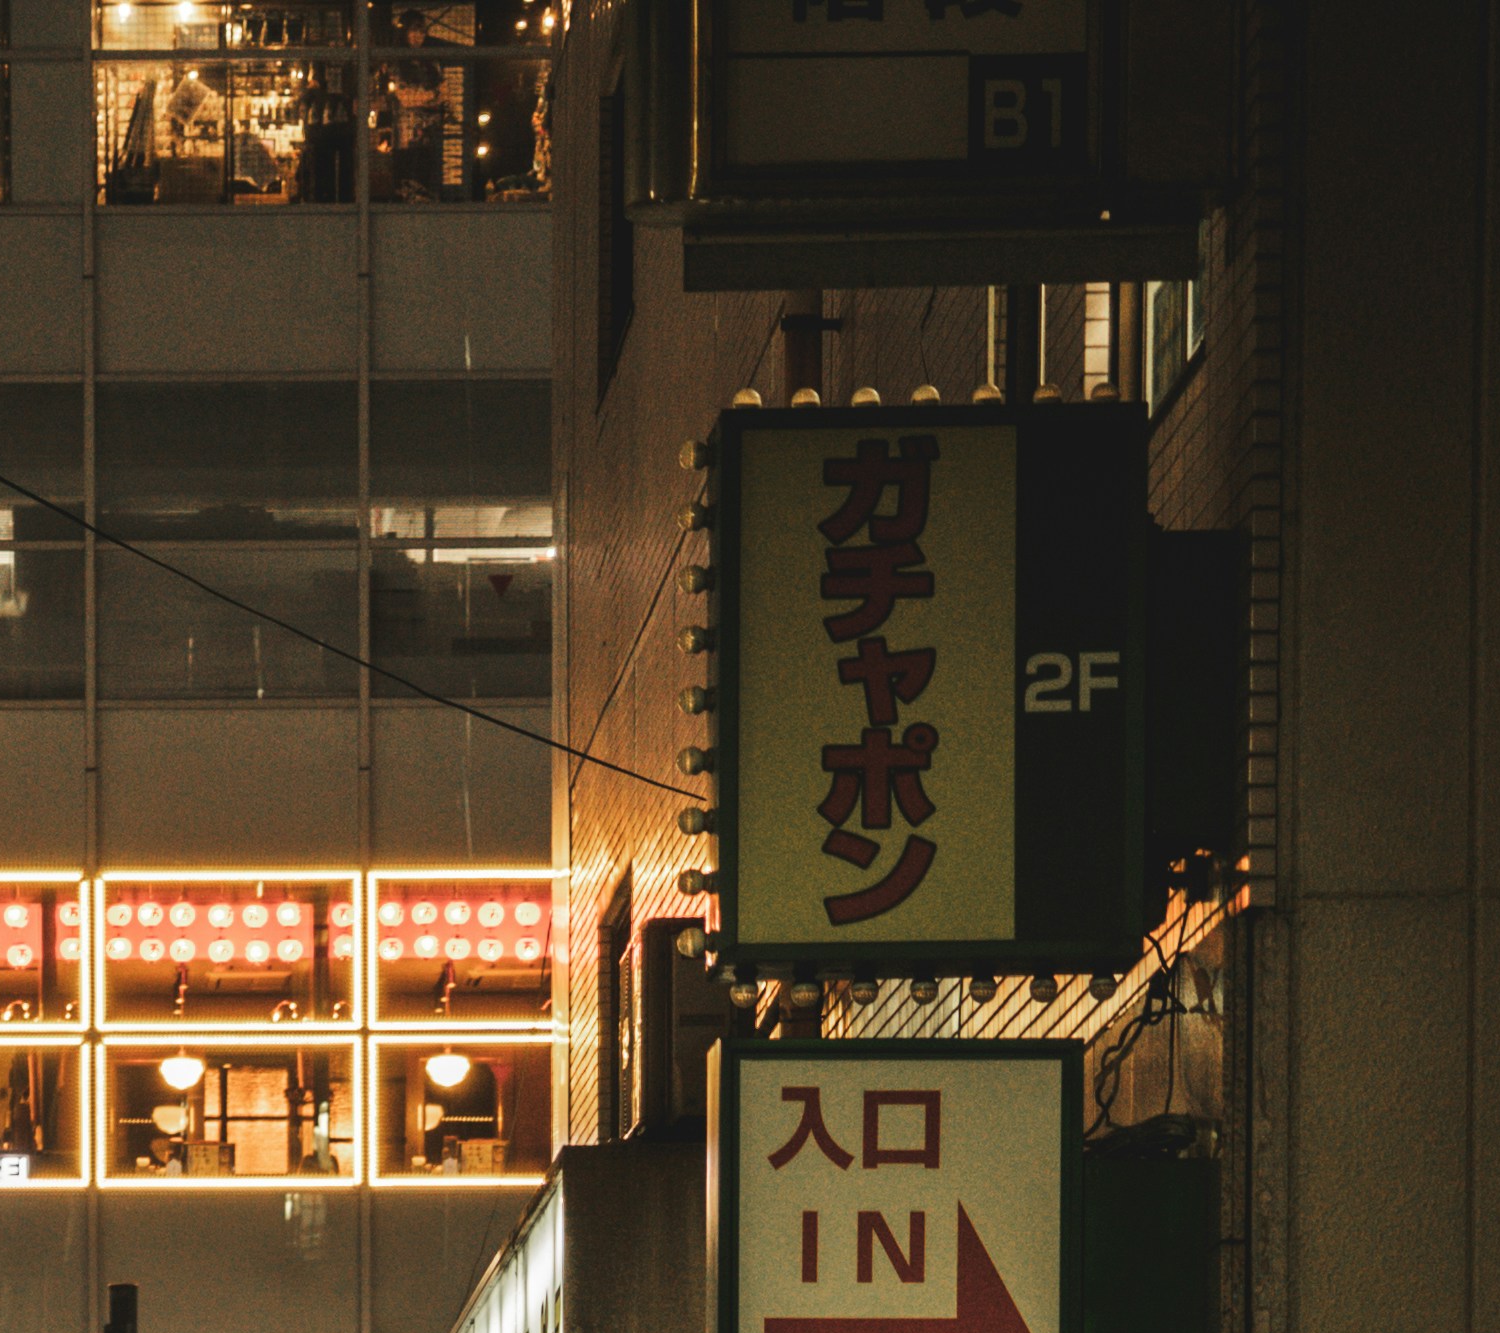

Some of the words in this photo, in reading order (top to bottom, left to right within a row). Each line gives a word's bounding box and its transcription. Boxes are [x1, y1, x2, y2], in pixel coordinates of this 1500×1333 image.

[983, 78, 1062, 149] B1
[816, 435, 940, 928] ガチャポン
[1024, 650, 1121, 714] 2F
[767, 1086, 941, 1171] 入口
[801, 1210, 926, 1284] IN
